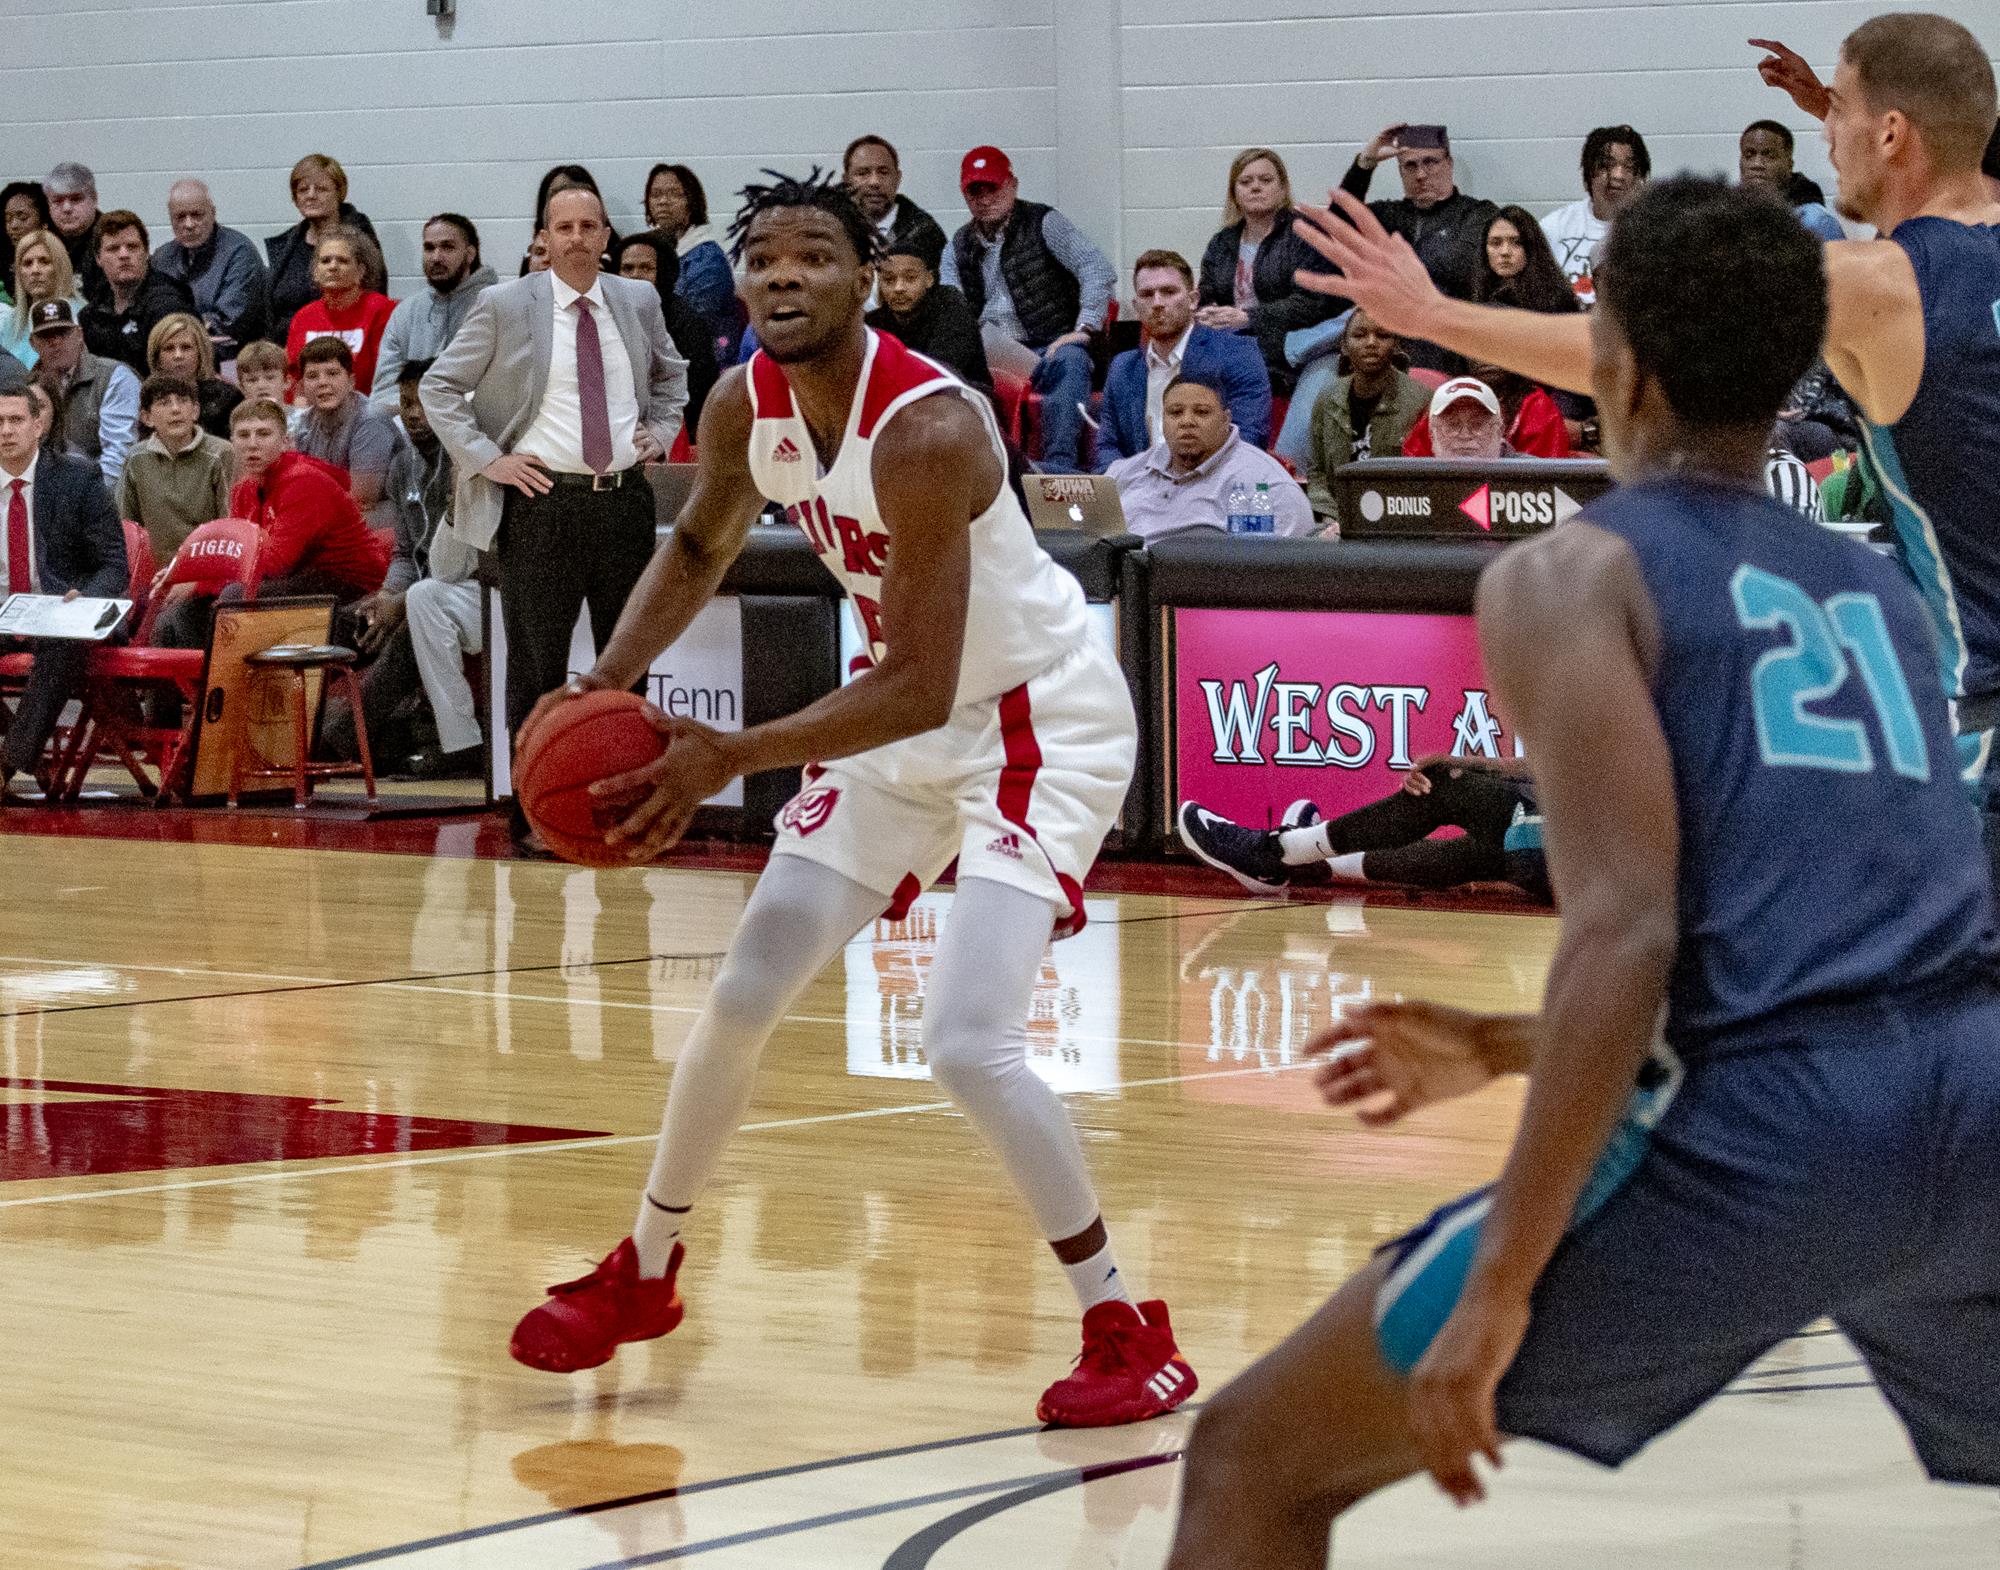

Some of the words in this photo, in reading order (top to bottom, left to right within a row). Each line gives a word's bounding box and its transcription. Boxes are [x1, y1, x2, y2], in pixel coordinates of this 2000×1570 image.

[1387, 496, 1431, 516] BONUS
[1490, 491, 1553, 523] POSS
[190, 539, 243, 559] TIGERS
[1730, 563, 1931, 783] 21
[1199, 661, 1430, 770] WEST
[1451, 689, 1526, 759] A
